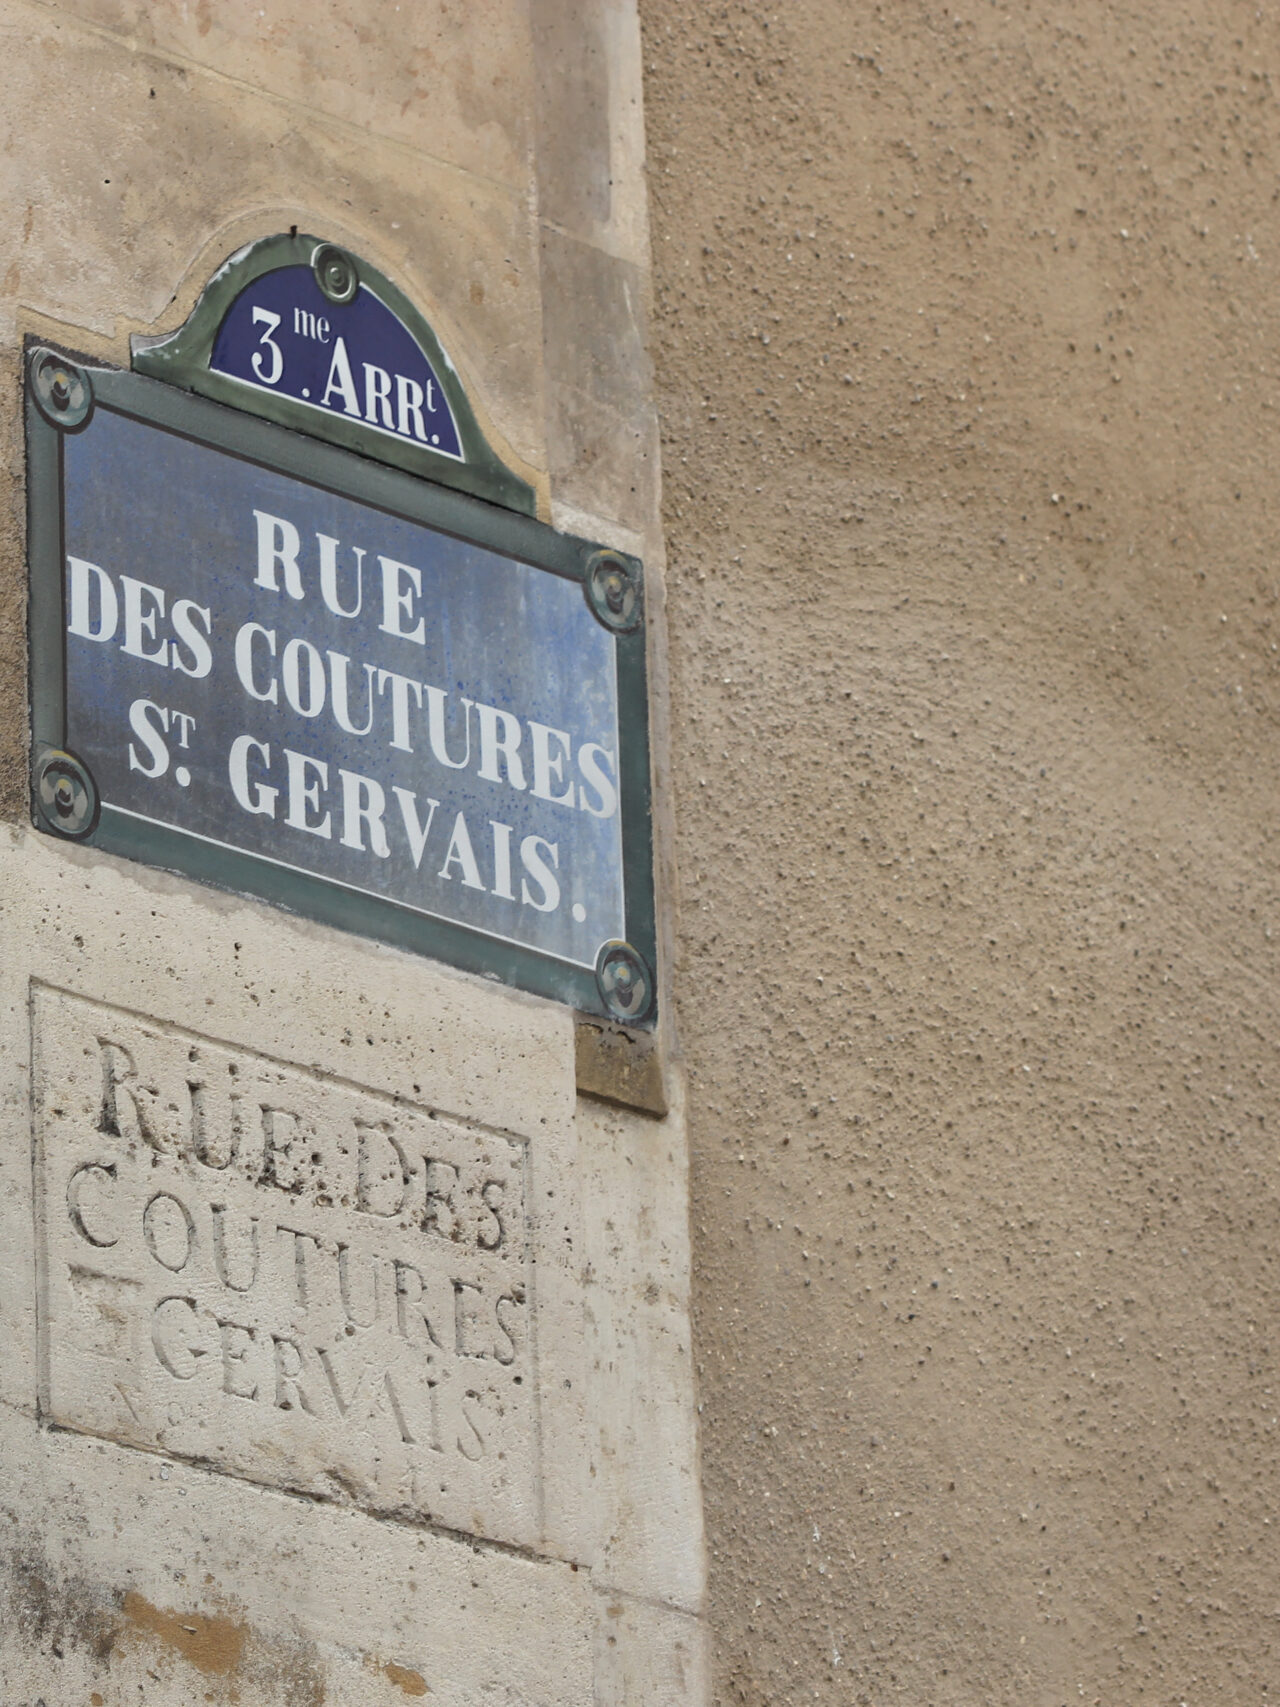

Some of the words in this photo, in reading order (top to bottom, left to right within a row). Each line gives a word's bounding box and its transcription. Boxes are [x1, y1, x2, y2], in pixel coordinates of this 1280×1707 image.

[252, 509, 426, 645] RUE
[67, 555, 213, 678] DES
[234, 622, 617, 818] COUTURES
[228, 735, 587, 923] GERVAIS.
[94, 1036, 303, 1195] RUE
[354, 1116, 508, 1251] DES
[66, 1161, 526, 1365] COUTURES
[151, 1296, 487, 1461] GERVAIS
